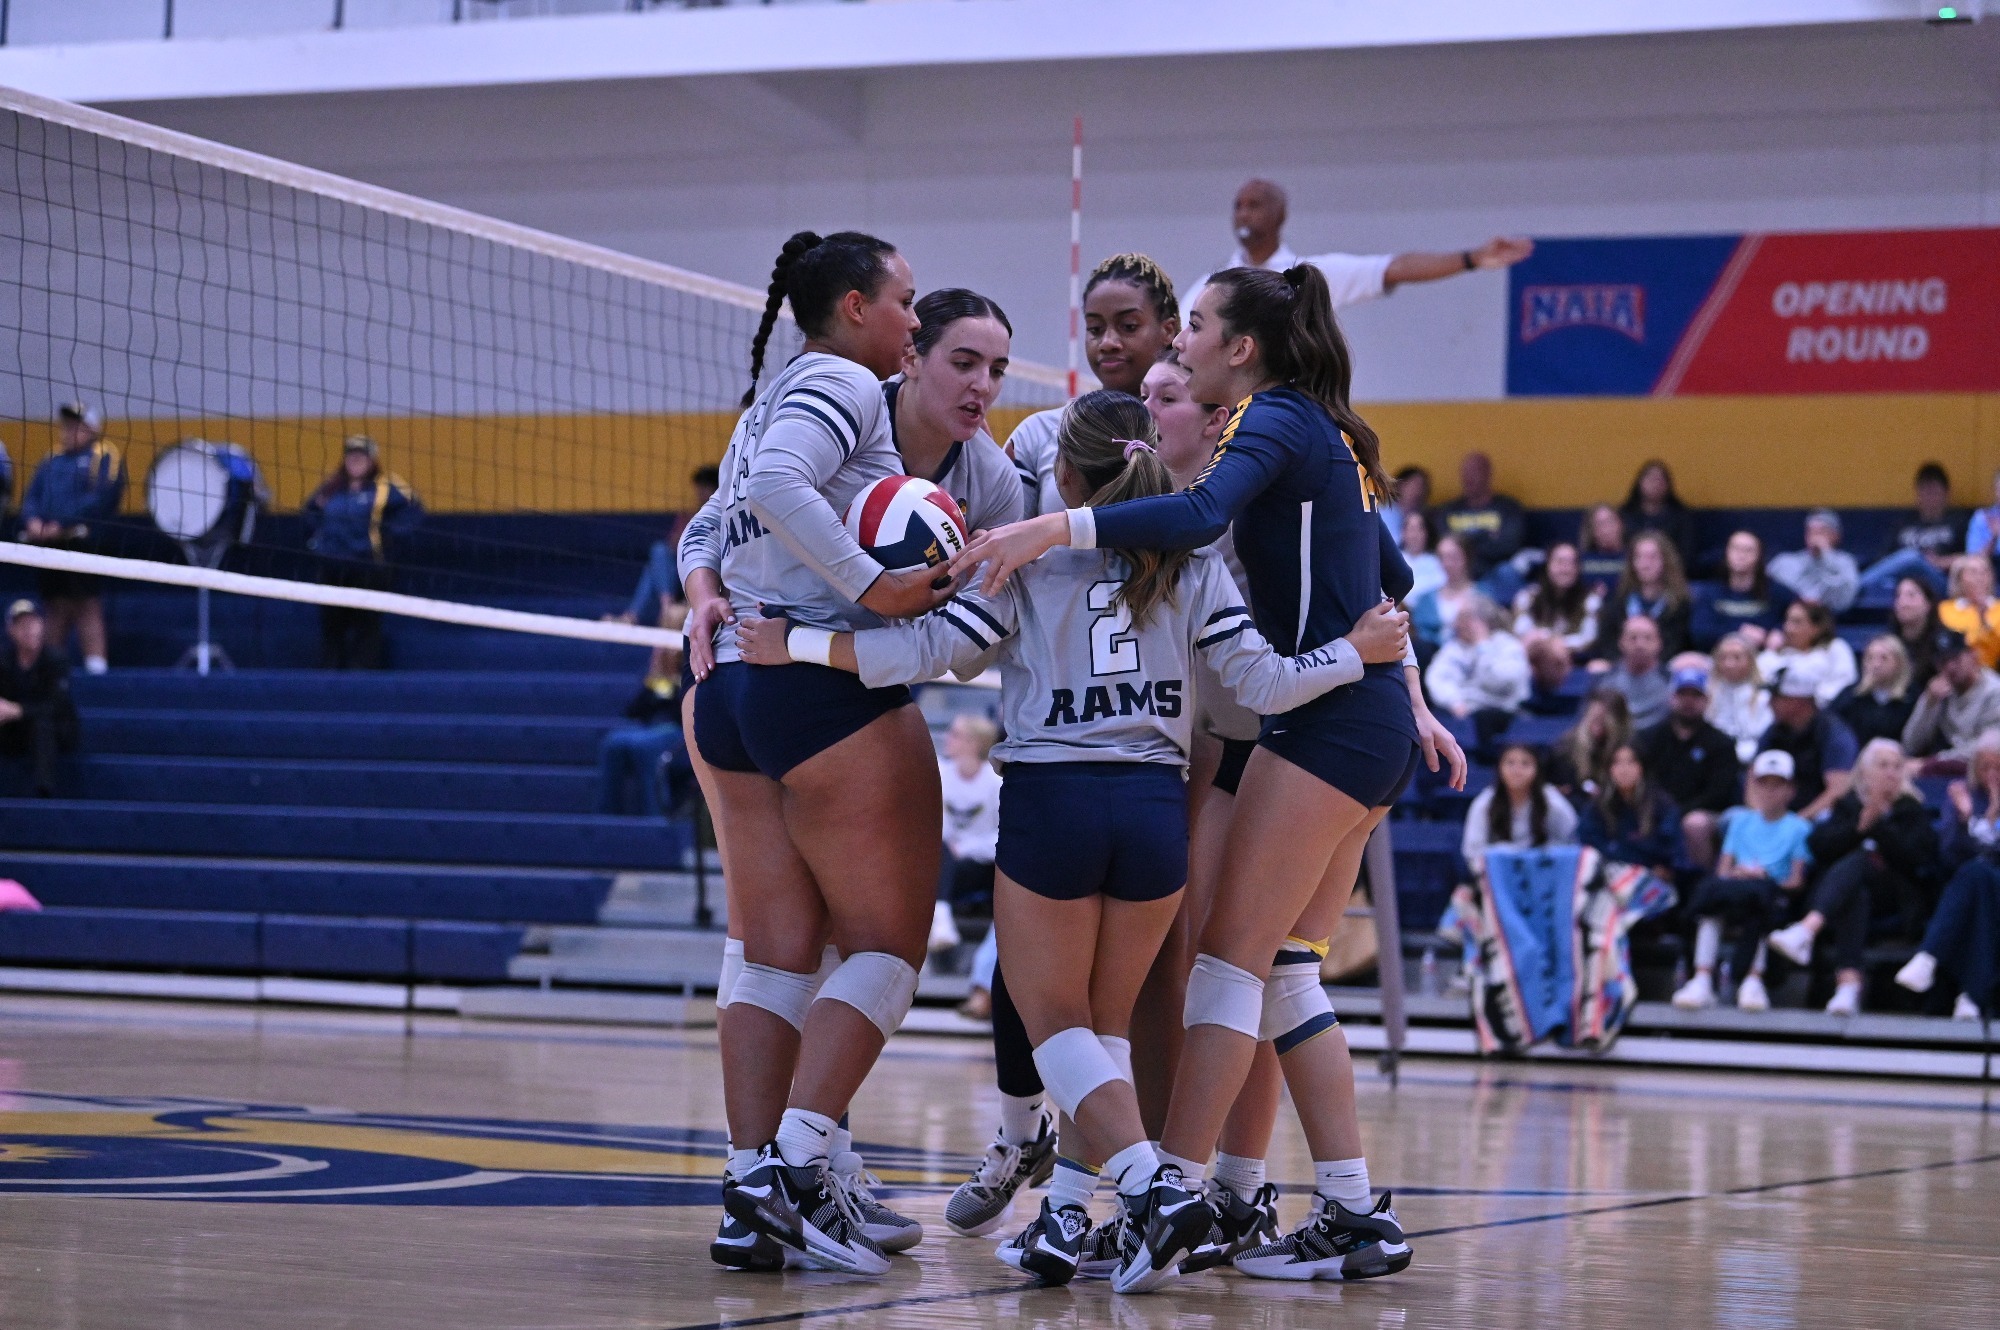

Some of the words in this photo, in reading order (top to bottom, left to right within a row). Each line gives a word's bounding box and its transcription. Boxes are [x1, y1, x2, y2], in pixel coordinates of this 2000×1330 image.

[1772, 277, 1948, 317] OPENING
[1785, 325, 1929, 363] ROUND
[1086, 579, 1141, 678] 2
[1043, 679, 1183, 727] RAMS
